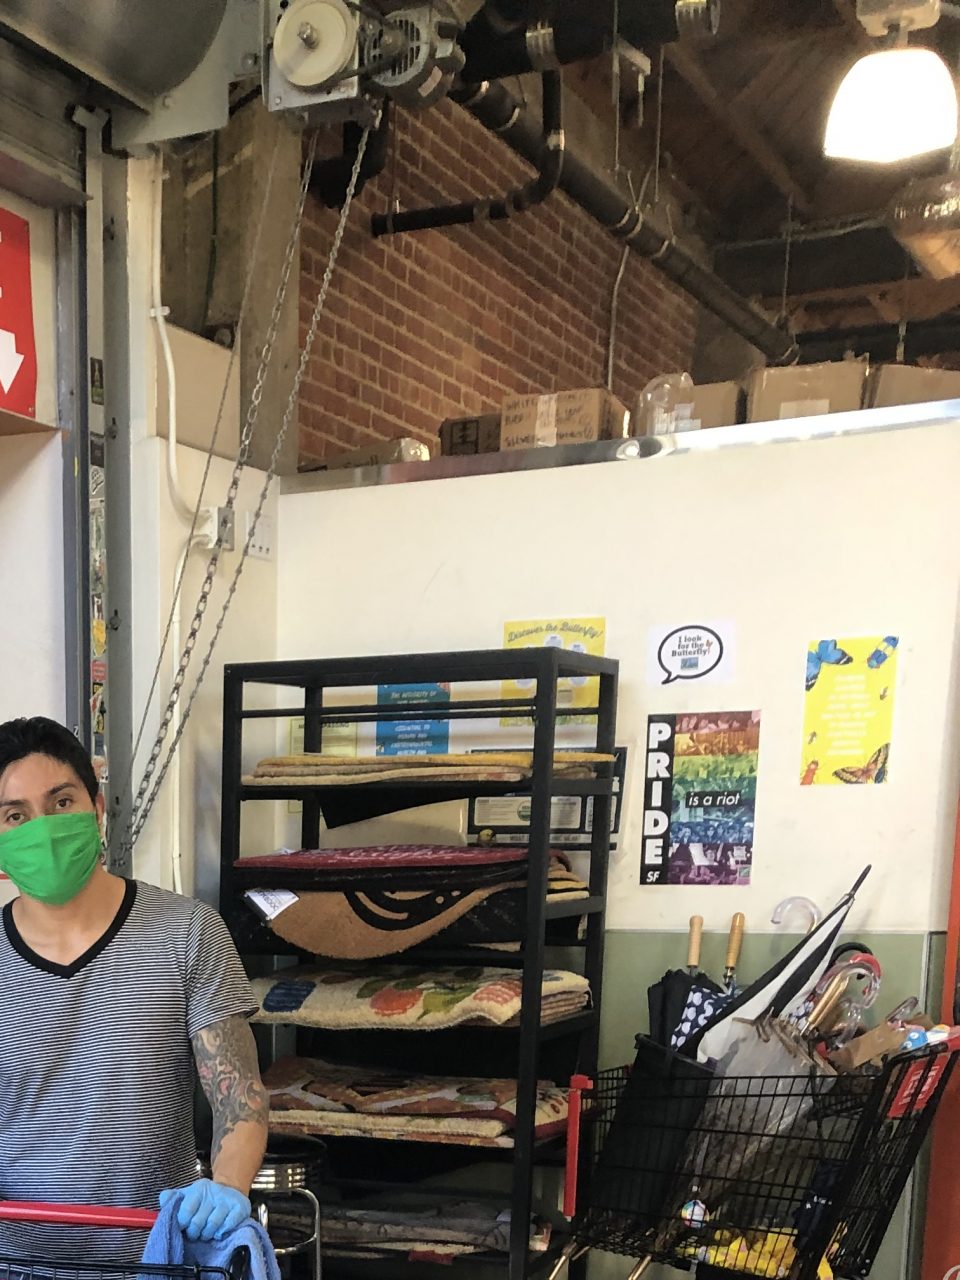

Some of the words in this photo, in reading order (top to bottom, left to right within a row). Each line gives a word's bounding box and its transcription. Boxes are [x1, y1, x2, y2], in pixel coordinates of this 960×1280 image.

[643, 722, 672, 865] PRIDE
[688, 793, 700, 806] is
[702, 795, 714, 806] a
[716, 791, 740, 805] riot
[646, 871, 660, 882] SF
